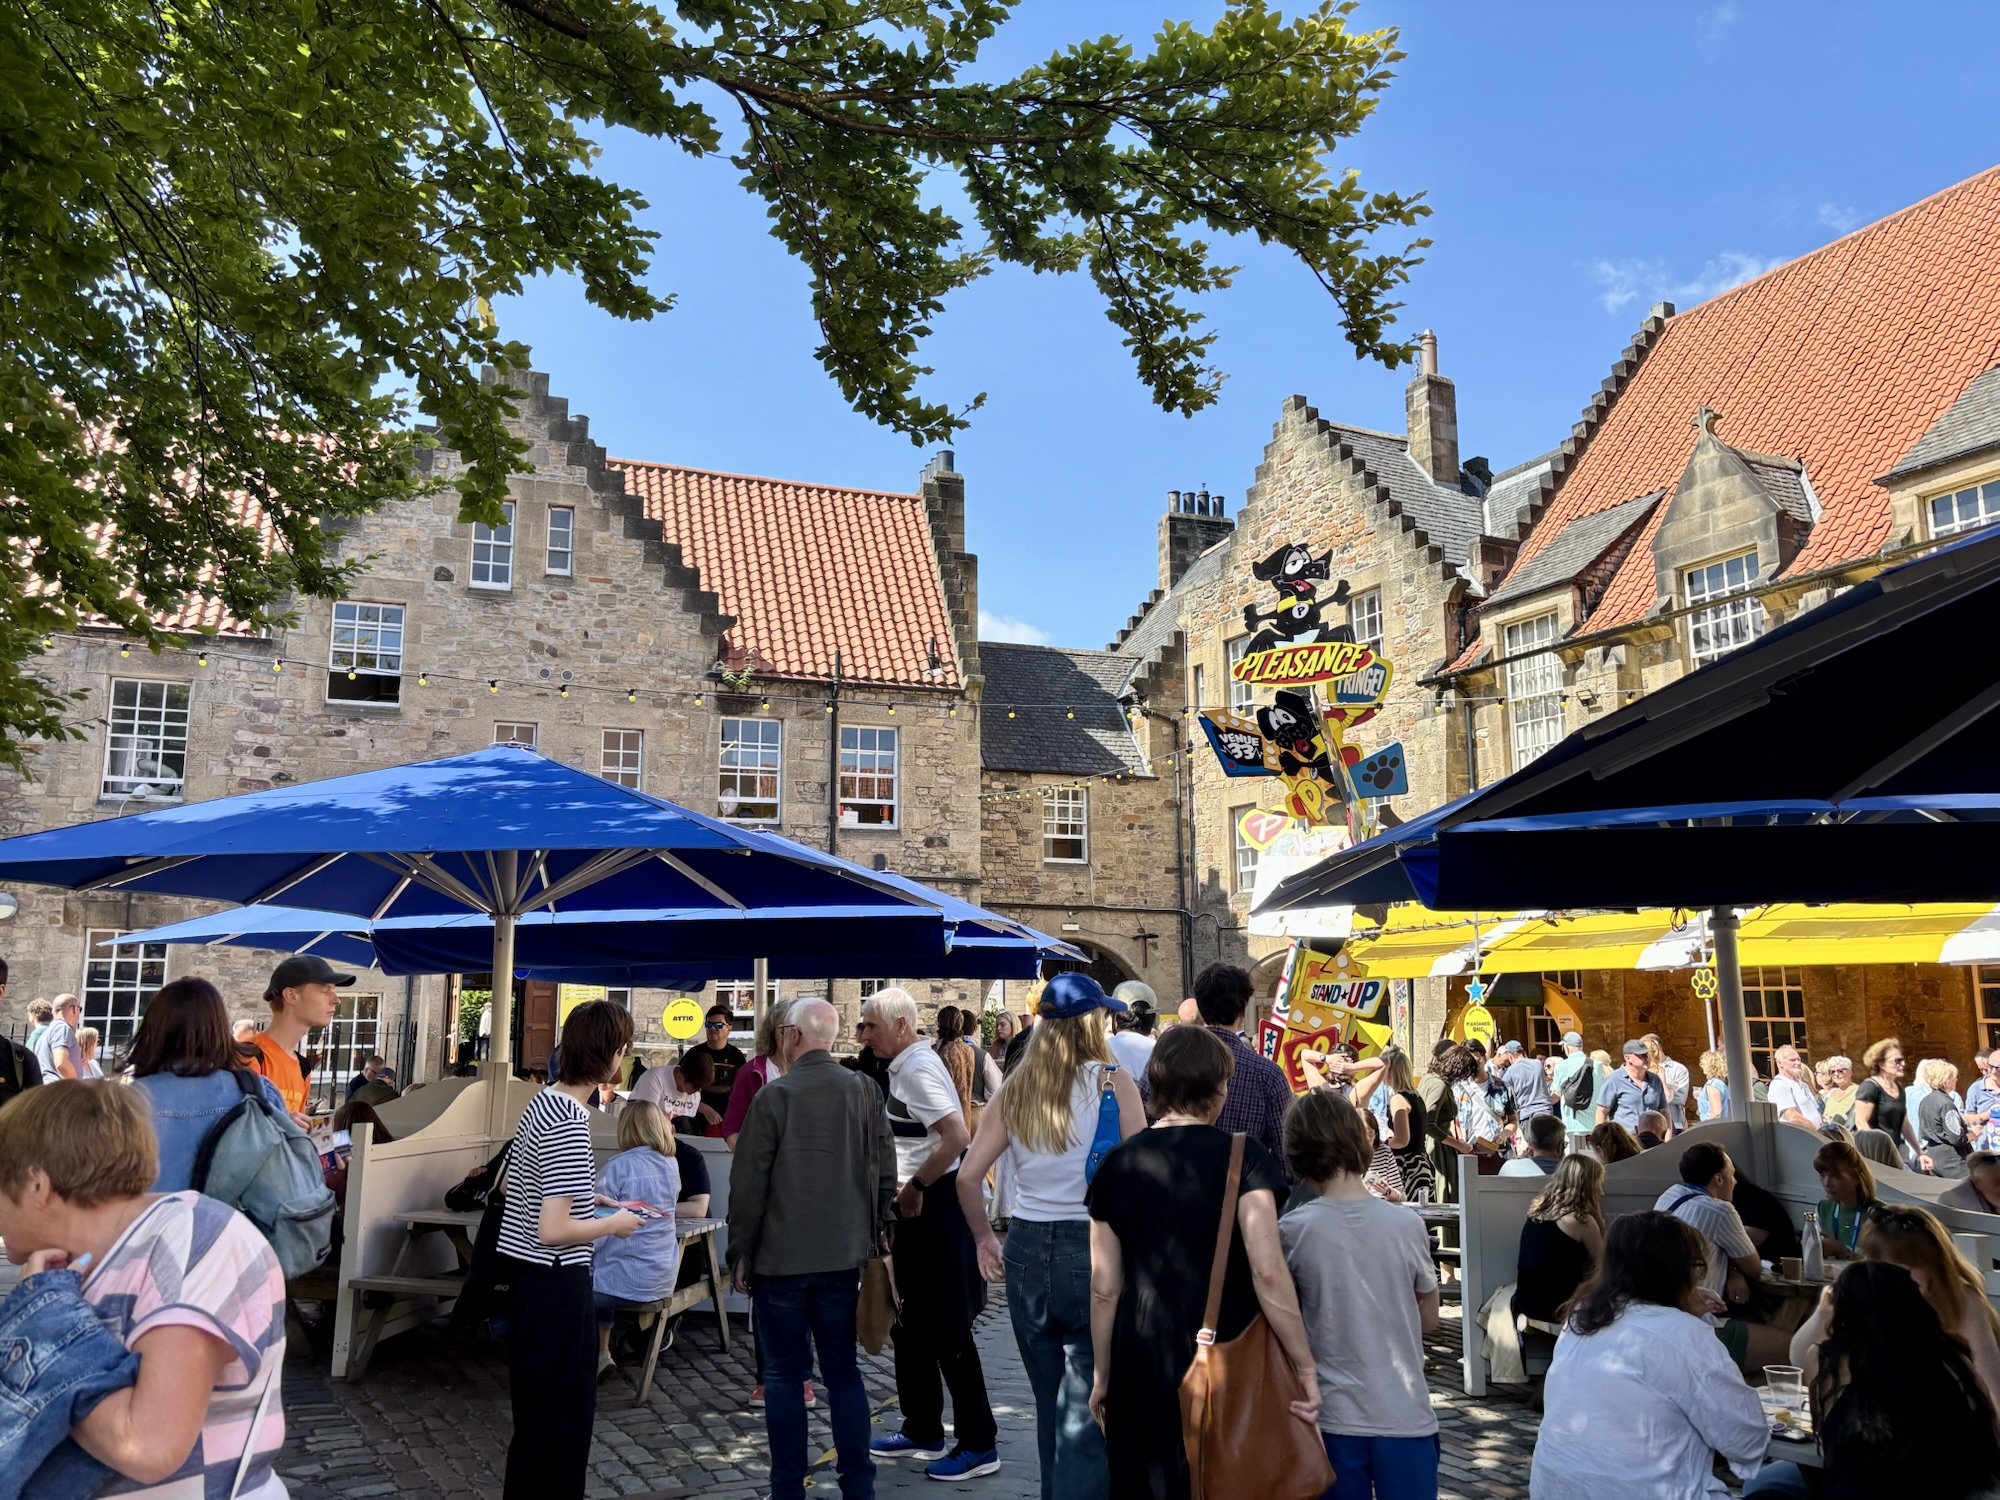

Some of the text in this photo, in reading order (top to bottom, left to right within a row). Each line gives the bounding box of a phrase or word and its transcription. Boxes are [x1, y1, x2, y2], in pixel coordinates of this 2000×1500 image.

[1238, 644, 1368, 682] PLEASANCE
[1219, 732, 1260, 747] VENUE
[1228, 742, 1256, 760] 33
[1295, 779, 1322, 822] P
[1251, 814, 1284, 842] P
[1310, 984, 1342, 1004] STAND
[1347, 981, 1380, 1010] UP
